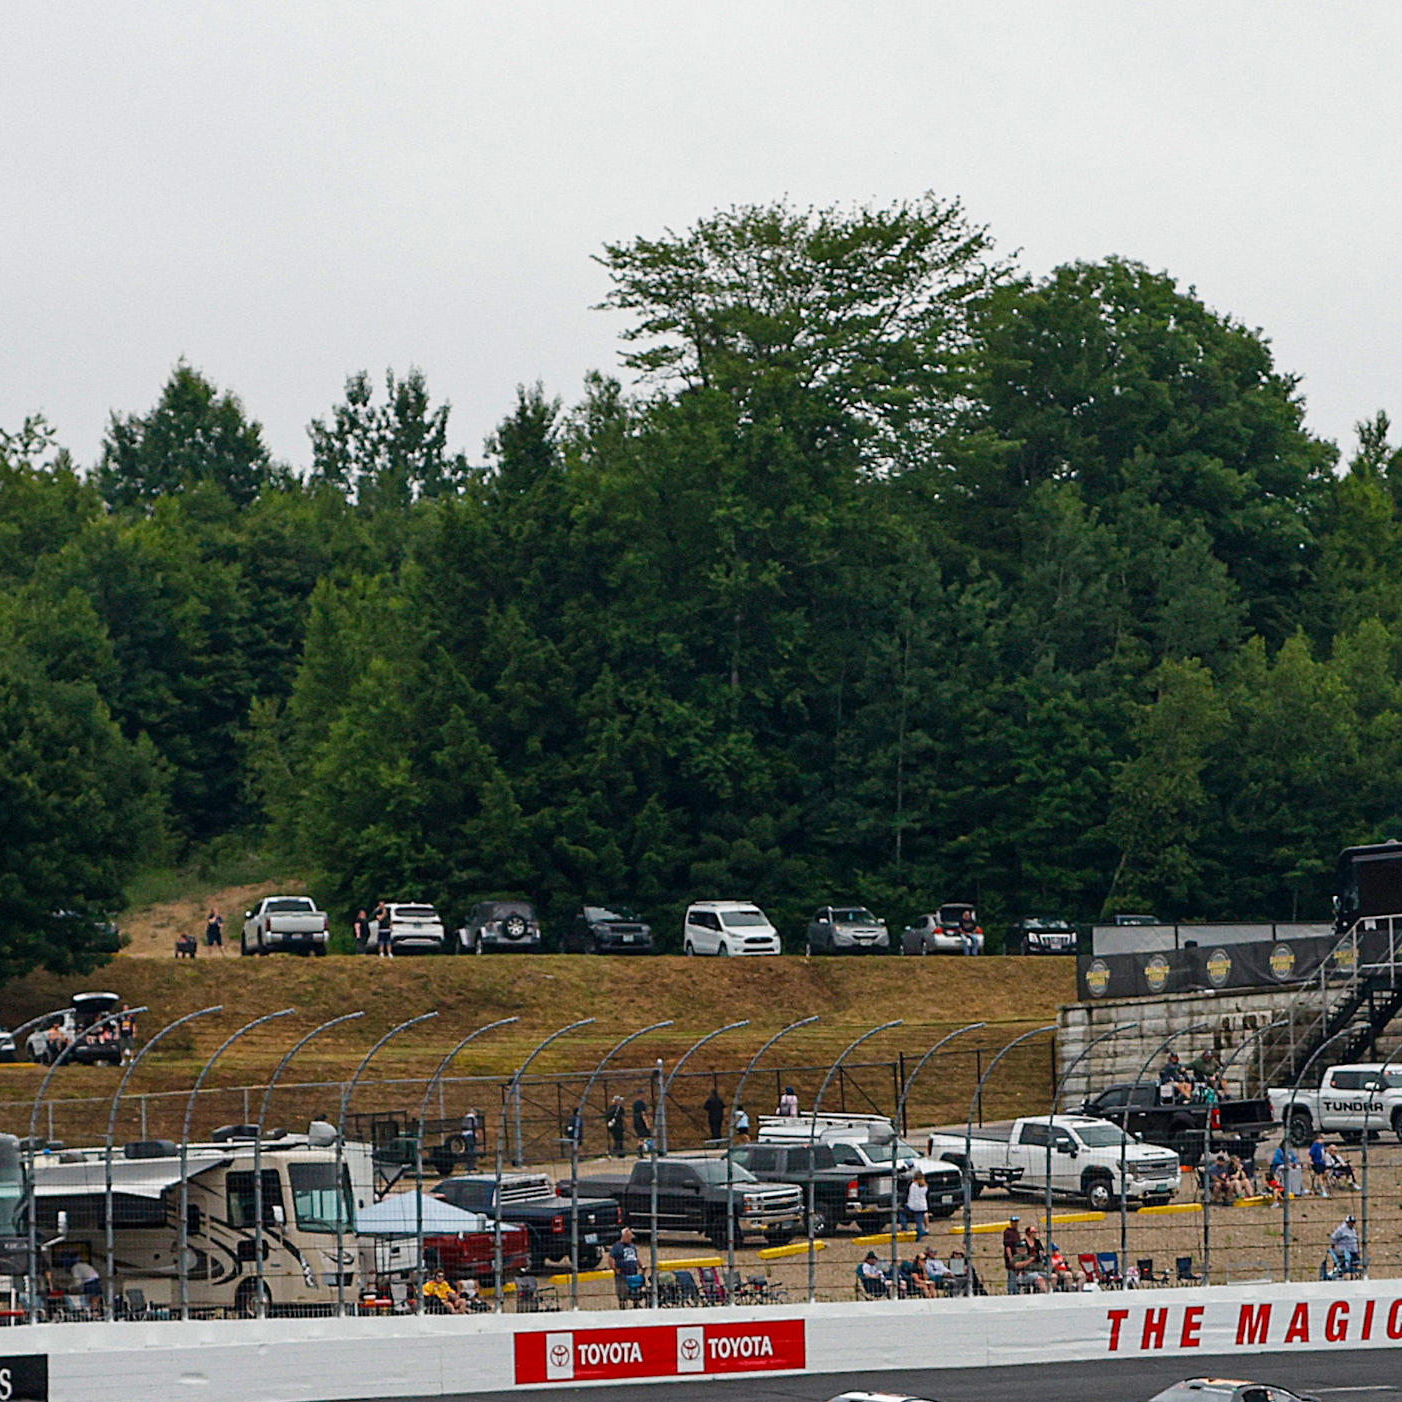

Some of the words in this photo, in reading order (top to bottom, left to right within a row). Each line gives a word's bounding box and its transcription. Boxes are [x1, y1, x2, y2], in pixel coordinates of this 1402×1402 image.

[1323, 1102, 1384, 1111] TUNDRA
[1107, 1305, 1205, 1350] THE
[578, 1342, 643, 1366] TOYOTA
[708, 1335, 773, 1360] TOYOTA
